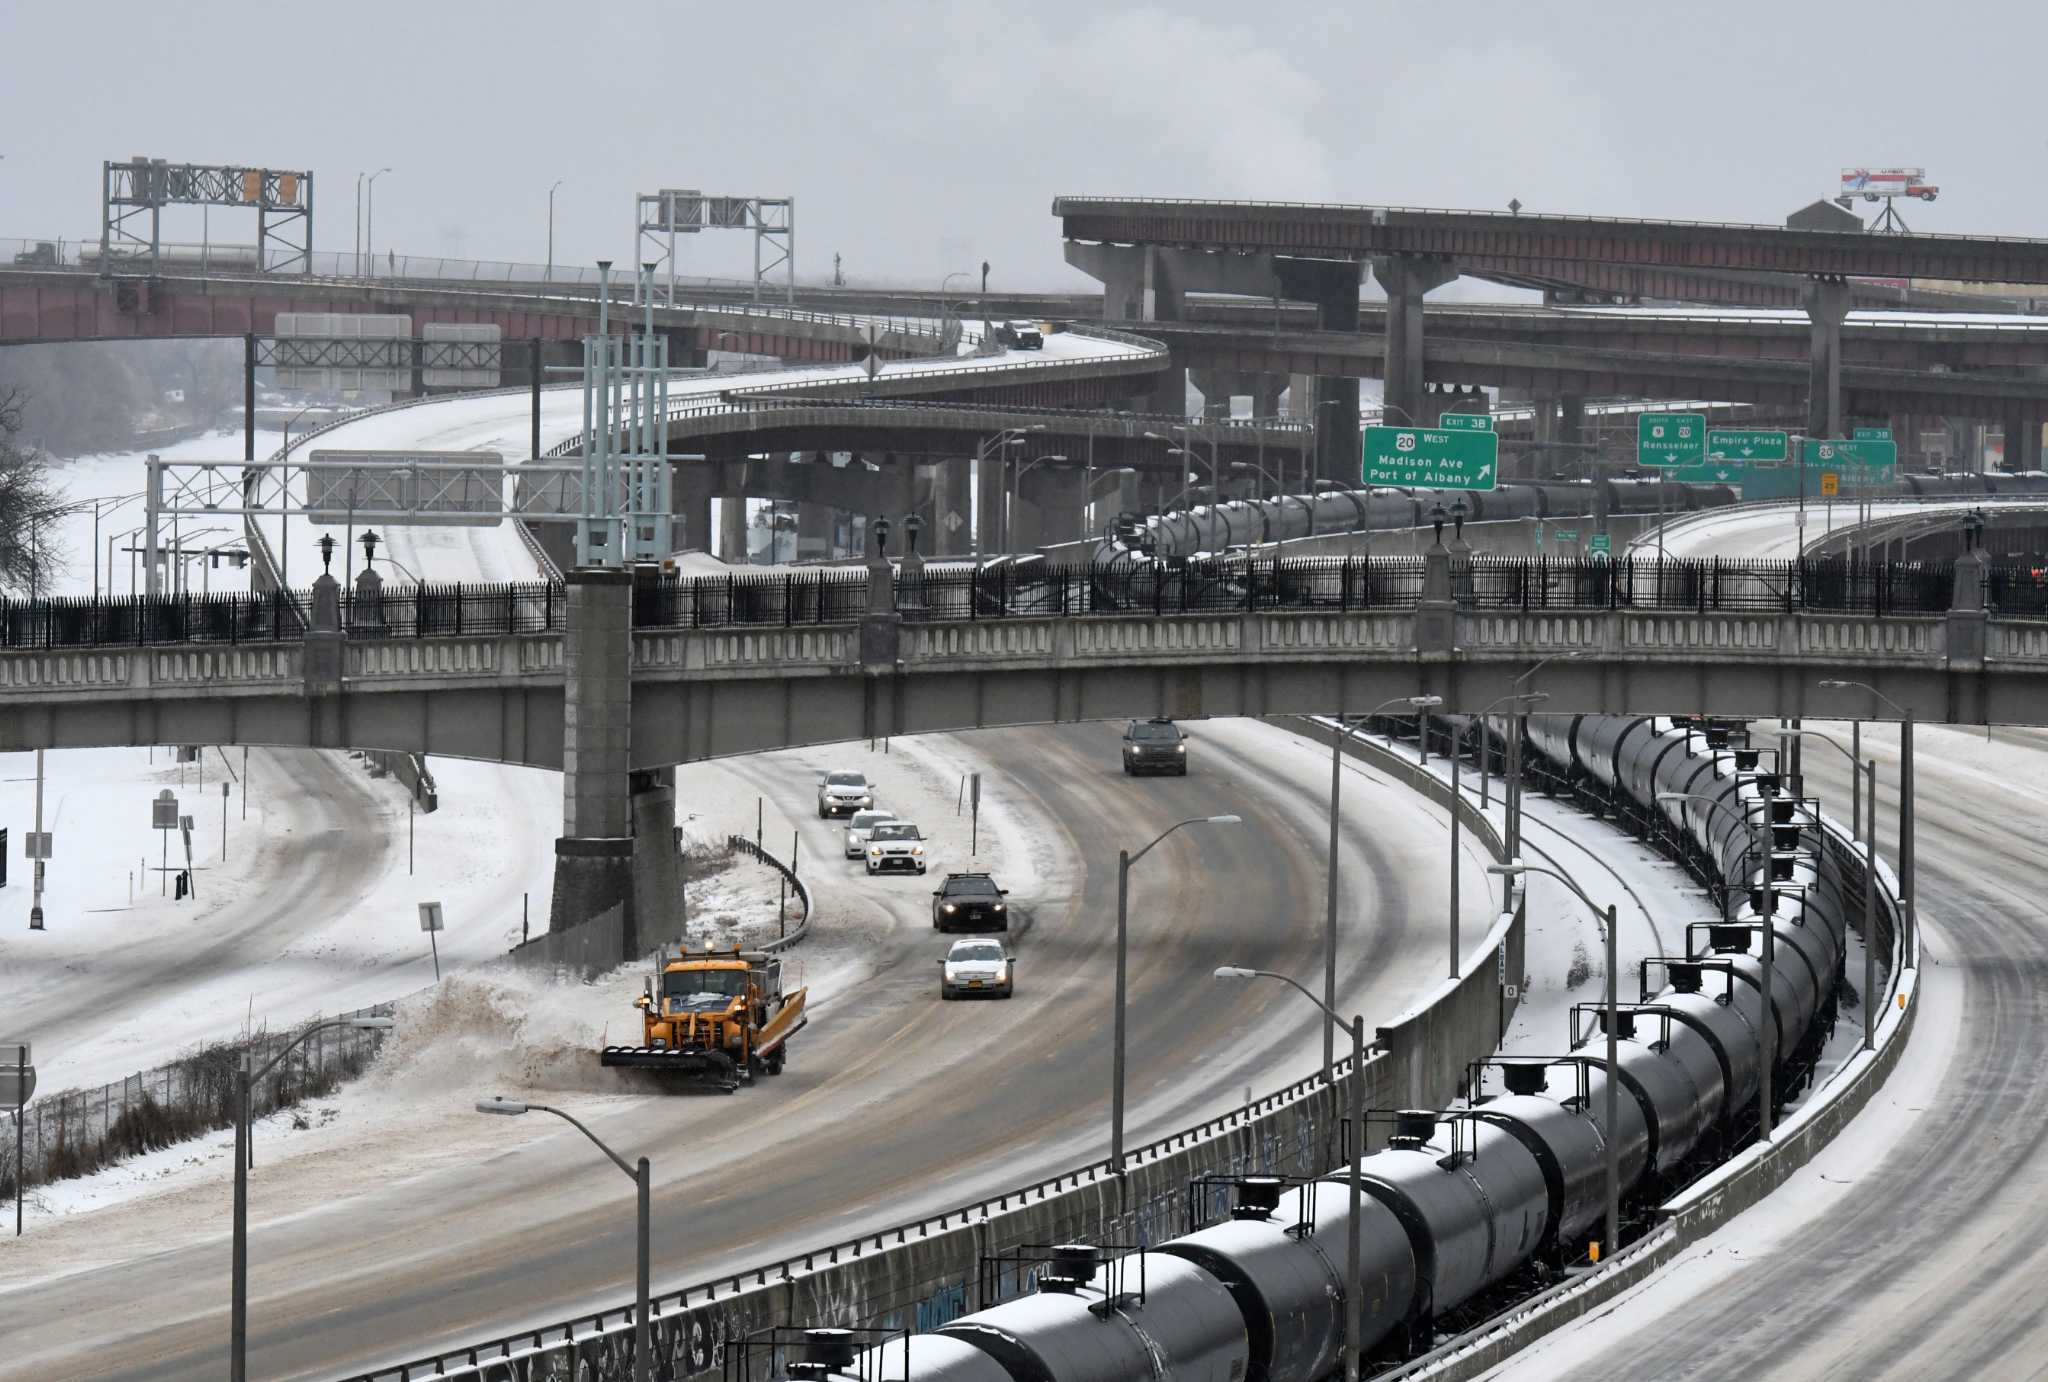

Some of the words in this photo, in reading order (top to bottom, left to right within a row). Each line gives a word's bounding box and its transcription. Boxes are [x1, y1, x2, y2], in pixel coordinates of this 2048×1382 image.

[1446, 418, 1464, 426] EXIT
[1471, 418, 1486, 429] 3B
[1679, 428, 1690, 436] 20
[1398, 437, 1414, 449] 20
[1423, 433, 1450, 444] WEST
[1643, 440, 1699, 450] Rensselaer
[1712, 436, 1749, 446] Empire
[1753, 437, 1783, 446] Plaza
[1820, 447, 1833, 458] 20
[1379, 455, 1432, 467] Madison
[1440, 458, 1464, 469] Ave
[1370, 469, 1398, 481] Port
[1405, 471, 1416, 481] of
[1424, 471, 1471, 486] Albany
